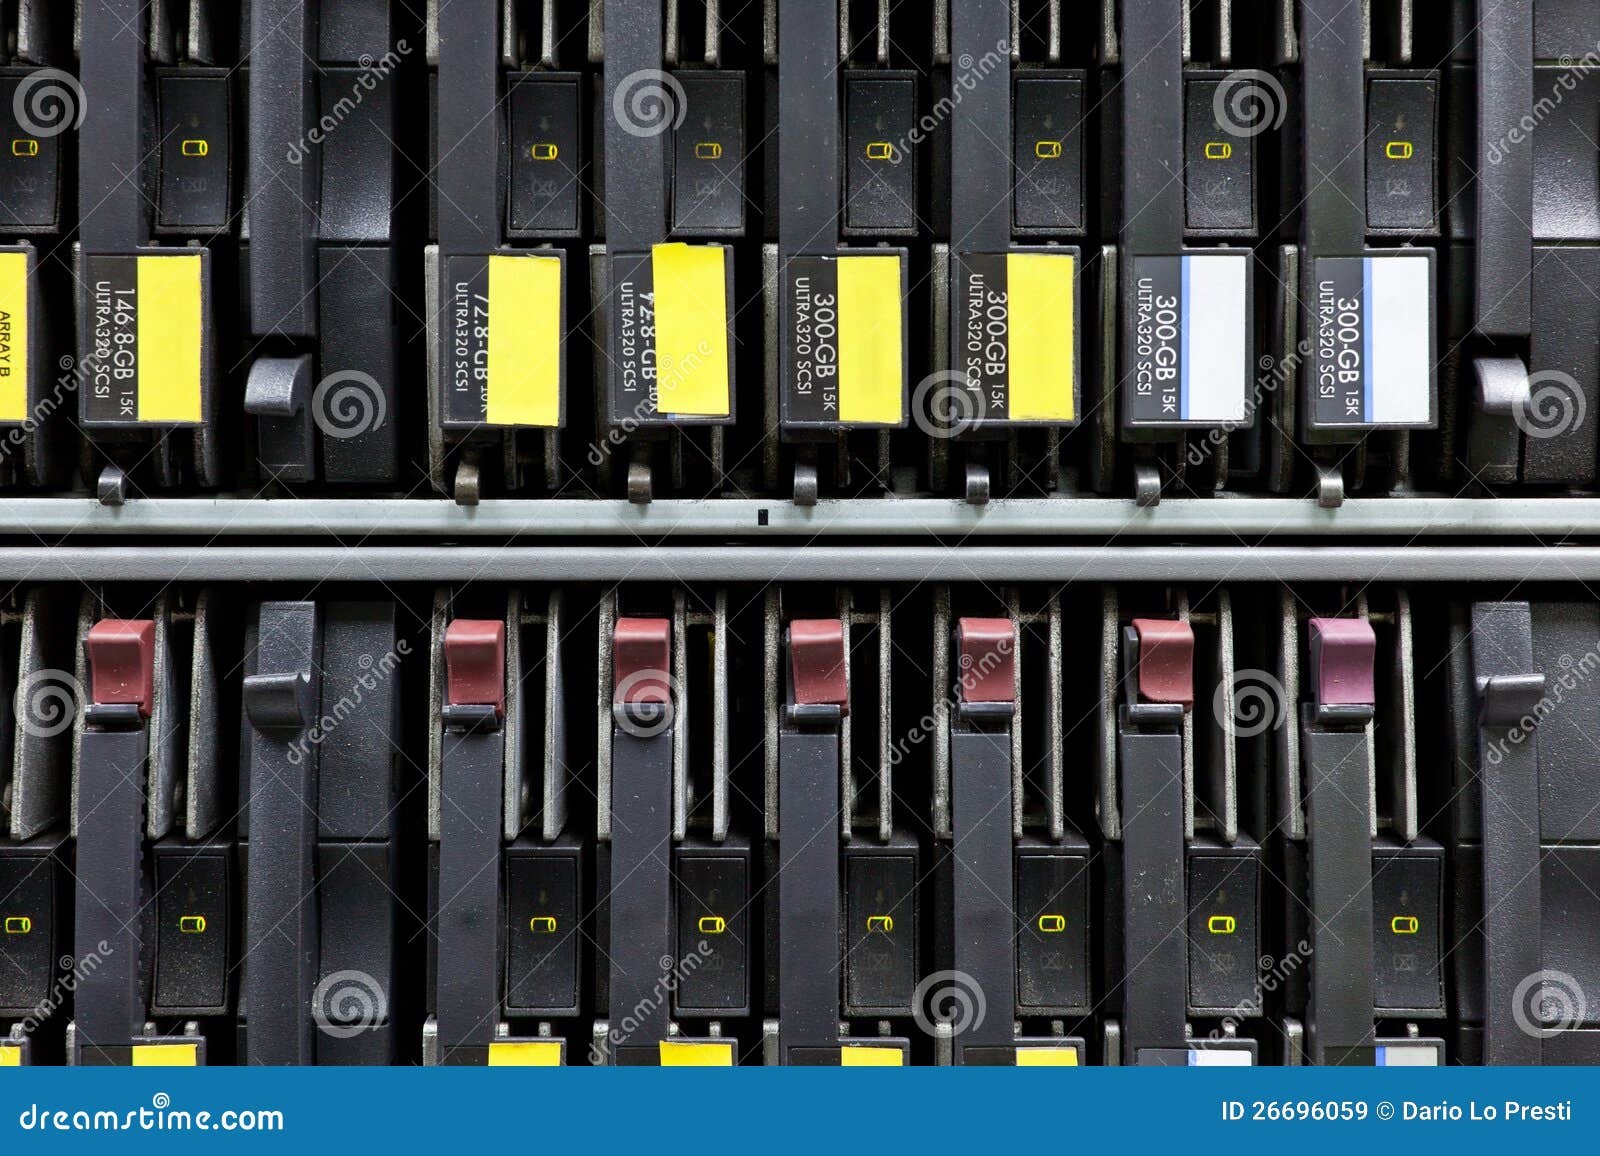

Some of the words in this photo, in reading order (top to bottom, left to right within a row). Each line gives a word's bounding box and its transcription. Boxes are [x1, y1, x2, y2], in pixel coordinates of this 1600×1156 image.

[95, 281, 111, 359] ULTRA320
[113, 288, 136, 380] 146.8-GB
[455, 282, 469, 356] ULTRA320
[620, 282, 636, 357] ULTRA320
[795, 277, 812, 355] ULTRA320
[967, 274, 984, 352] ULTRA320
[985, 292, 1008, 376] 300-GB
[1137, 278, 1153, 356] ULTRA320
[1319, 281, 1335, 359] ULTRA320
[0, 310, 11, 362] ARRAY
[814, 293, 836, 378] 300-GB
[1155, 295, 1177, 381] 300-GB
[1337, 298, 1360, 383] 300-GB
[0, 367, 11, 376] B
[94, 364, 110, 398] SCSI
[455, 361, 469, 392] SCSI
[623, 361, 637, 392] SCSI
[796, 361, 812, 395] SCSI
[966, 357, 982, 391] SCSI
[1136, 361, 1152, 396] SCSI
[1319, 365, 1335, 398] SCSI
[120, 390, 134, 416] 15K
[823, 386, 836, 411] 15K
[991, 384, 1005, 409] 15K
[1162, 387, 1176, 413] 15K
[1345, 390, 1360, 415] 15K
